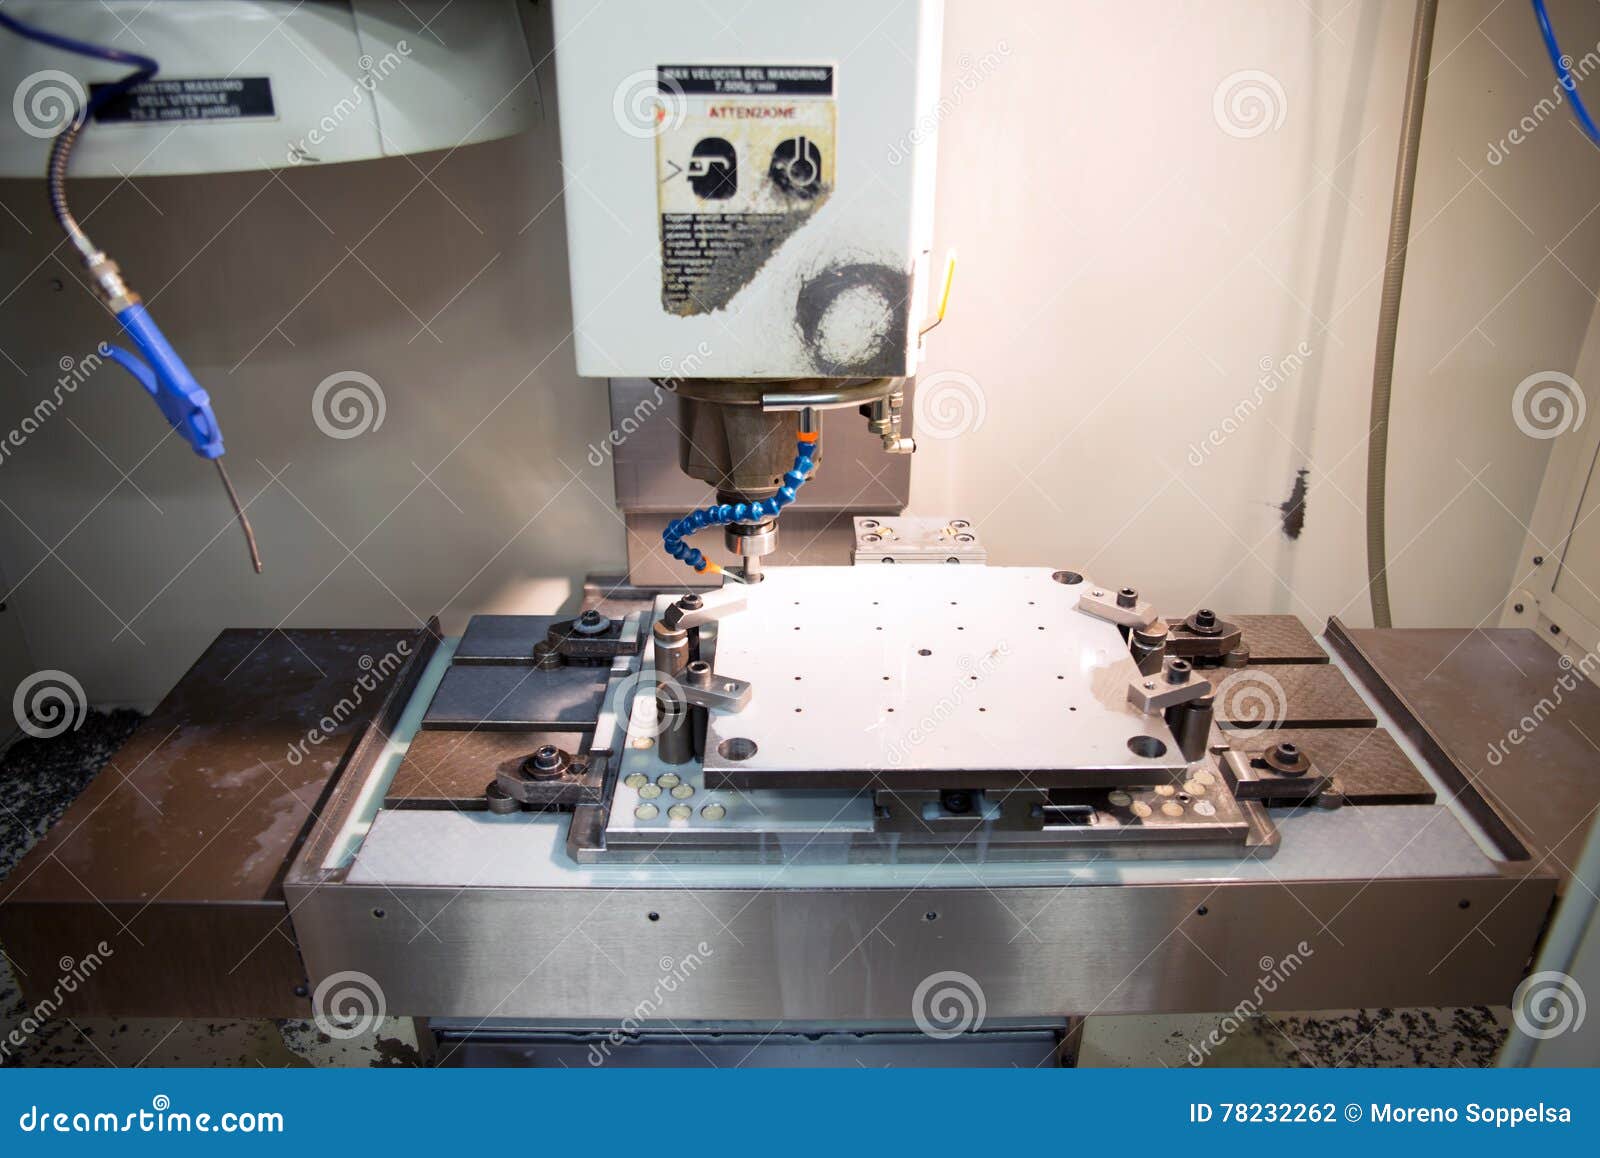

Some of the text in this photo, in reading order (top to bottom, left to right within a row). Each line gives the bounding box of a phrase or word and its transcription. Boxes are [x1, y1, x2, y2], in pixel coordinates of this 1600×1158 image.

[744, 68, 765, 80] DEL
[767, 68, 827, 80] MANDRINO
[184, 80, 244, 93] MASSIMO
[709, 107, 797, 119] ATTENZIONE
